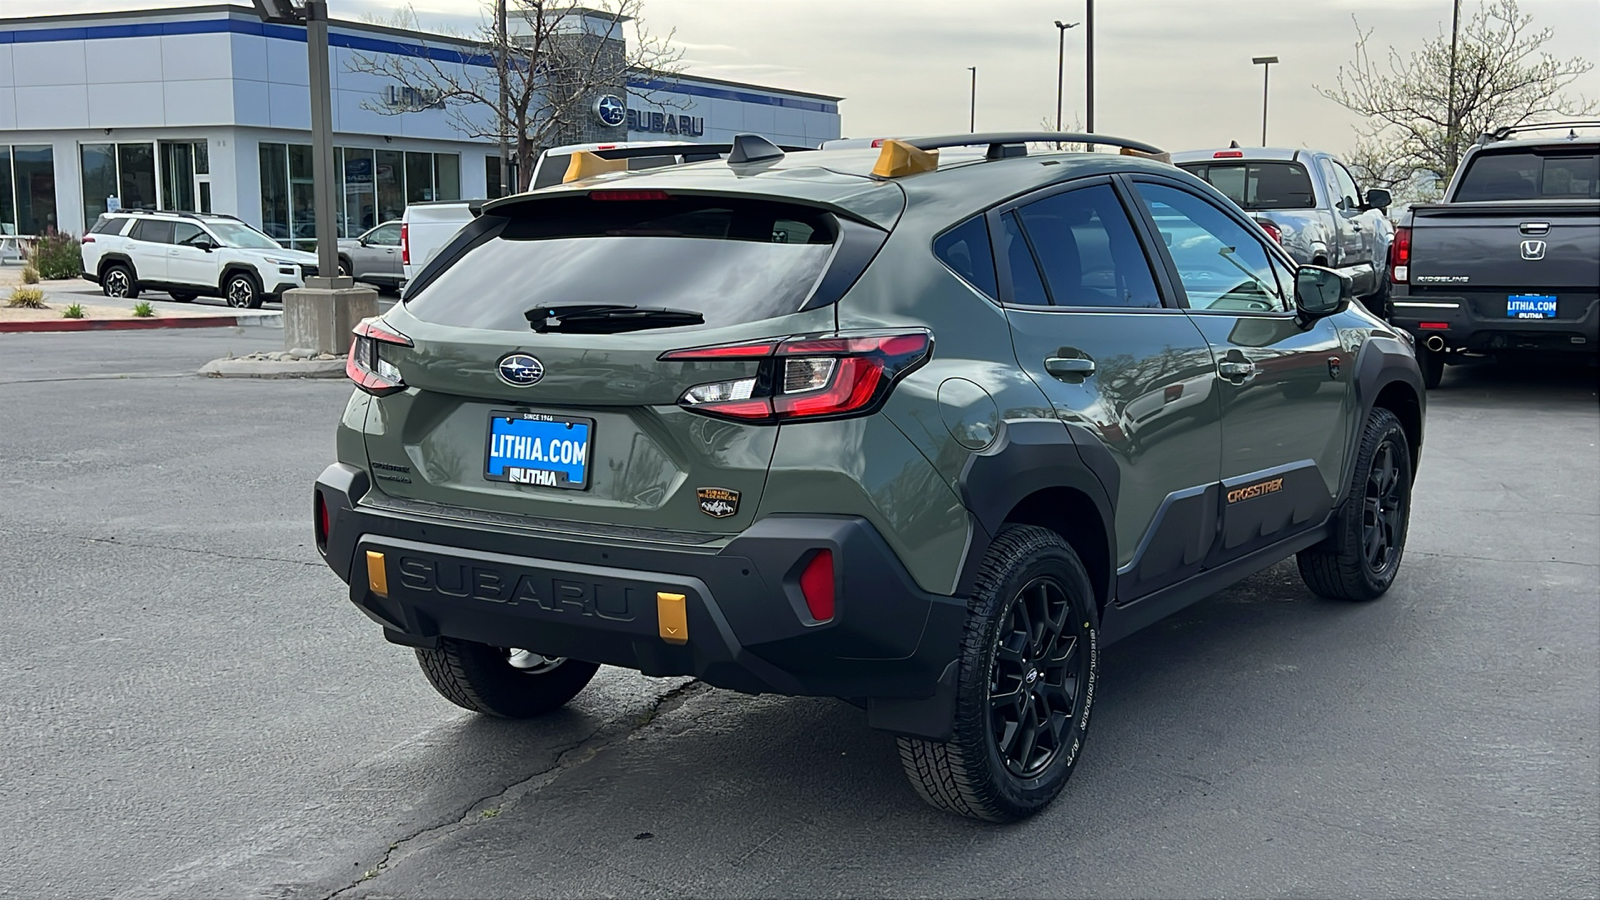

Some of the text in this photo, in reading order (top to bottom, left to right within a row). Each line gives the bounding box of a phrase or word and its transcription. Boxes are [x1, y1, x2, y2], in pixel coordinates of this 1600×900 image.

[627, 108, 704, 137] SUBARU
[1507, 301, 1557, 312] LITHIA.COM
[523, 413, 554, 422] SINCE 1946
[490, 433, 587, 466] LITHIA.COM
[520, 468, 557, 487] LITHIA
[1227, 478, 1283, 504] CROSSTREK
[399, 556, 636, 622] SUBARU
